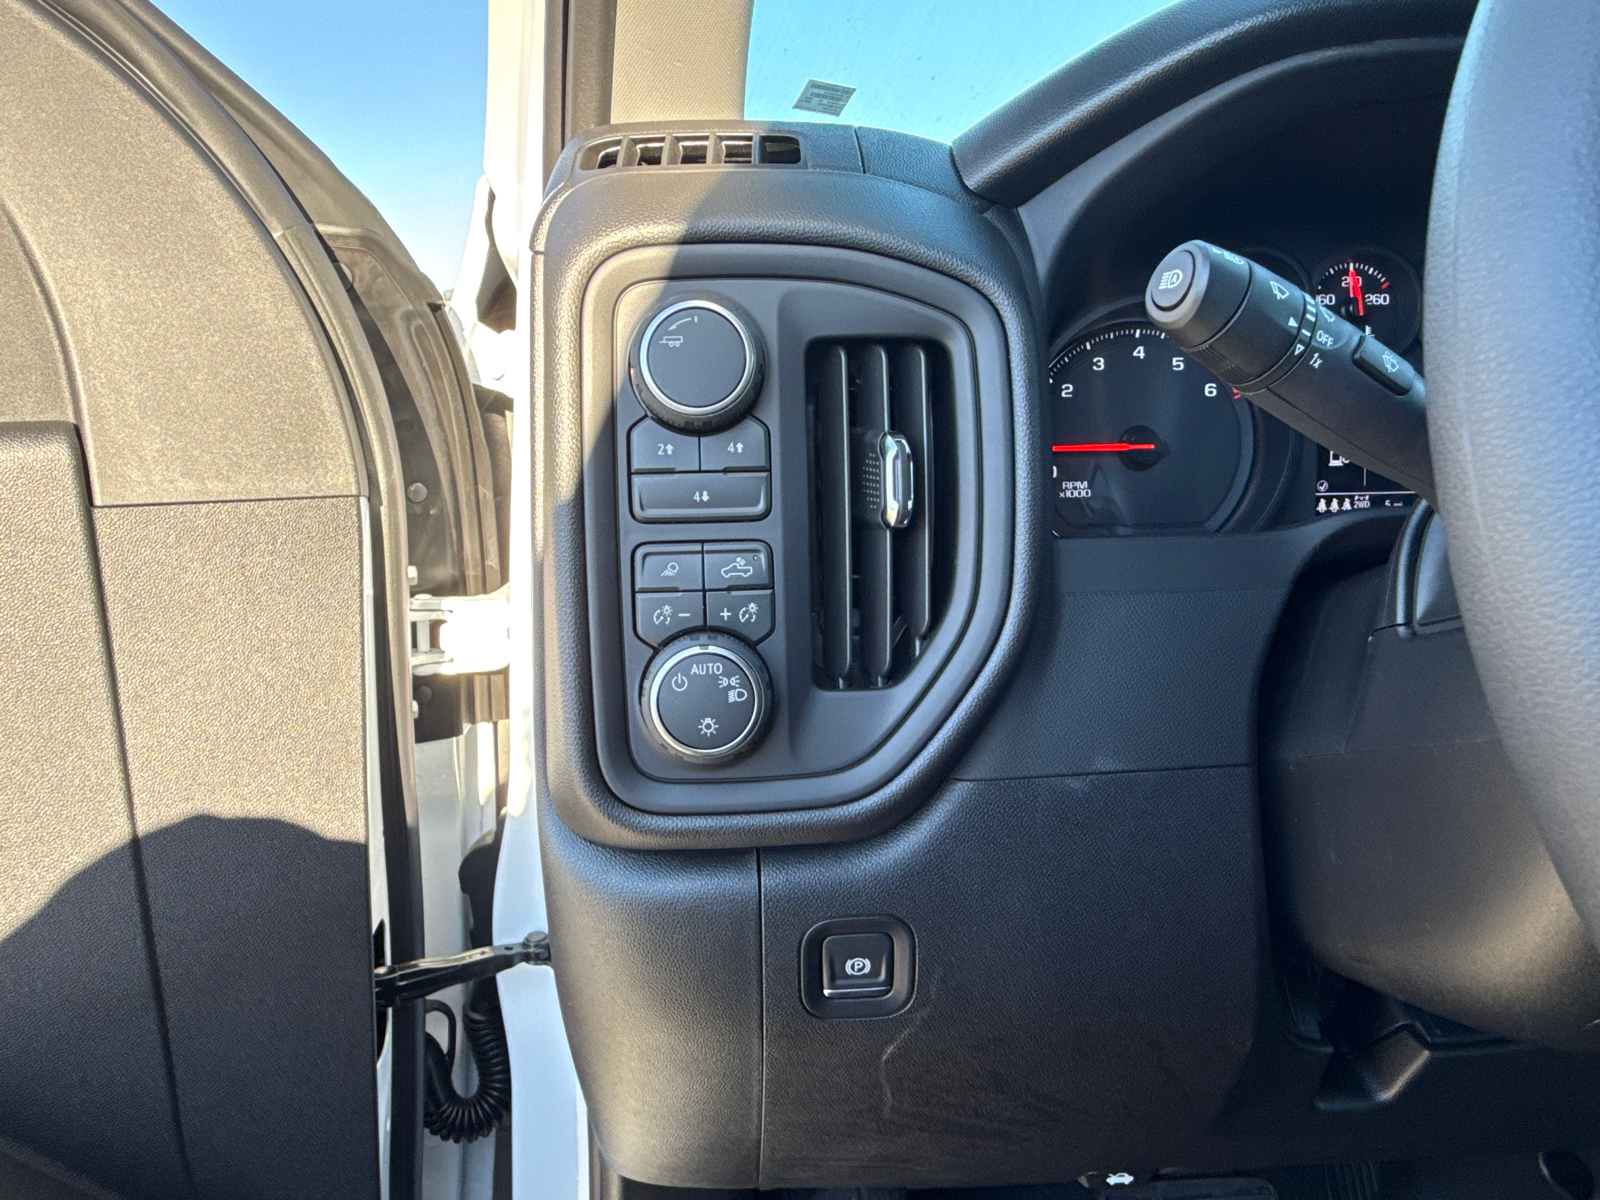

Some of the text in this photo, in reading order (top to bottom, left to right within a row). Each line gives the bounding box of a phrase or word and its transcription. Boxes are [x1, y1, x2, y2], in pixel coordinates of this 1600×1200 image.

[1341, 276, 1362, 288] 20
[1364, 293, 1390, 306] 260
[1316, 329, 1334, 347] OFF
[1132, 345, 1146, 360] 4
[1092, 356, 1105, 371] 3
[1171, 356, 1185, 371] 5
[1309, 352, 1323, 369] 1x
[1060, 383, 1074, 398] 2
[1203, 382, 1218, 397] 6
[657, 443, 665, 455] 2
[727, 442, 735, 453] 4
[1062, 480, 1088, 490] RPM
[692, 490, 701, 502] 4
[1059, 488, 1092, 498] x1000
[1353, 500, 1371, 509] 2WD
[690, 663, 723, 675] AUTO
[853, 961, 864, 972] P
